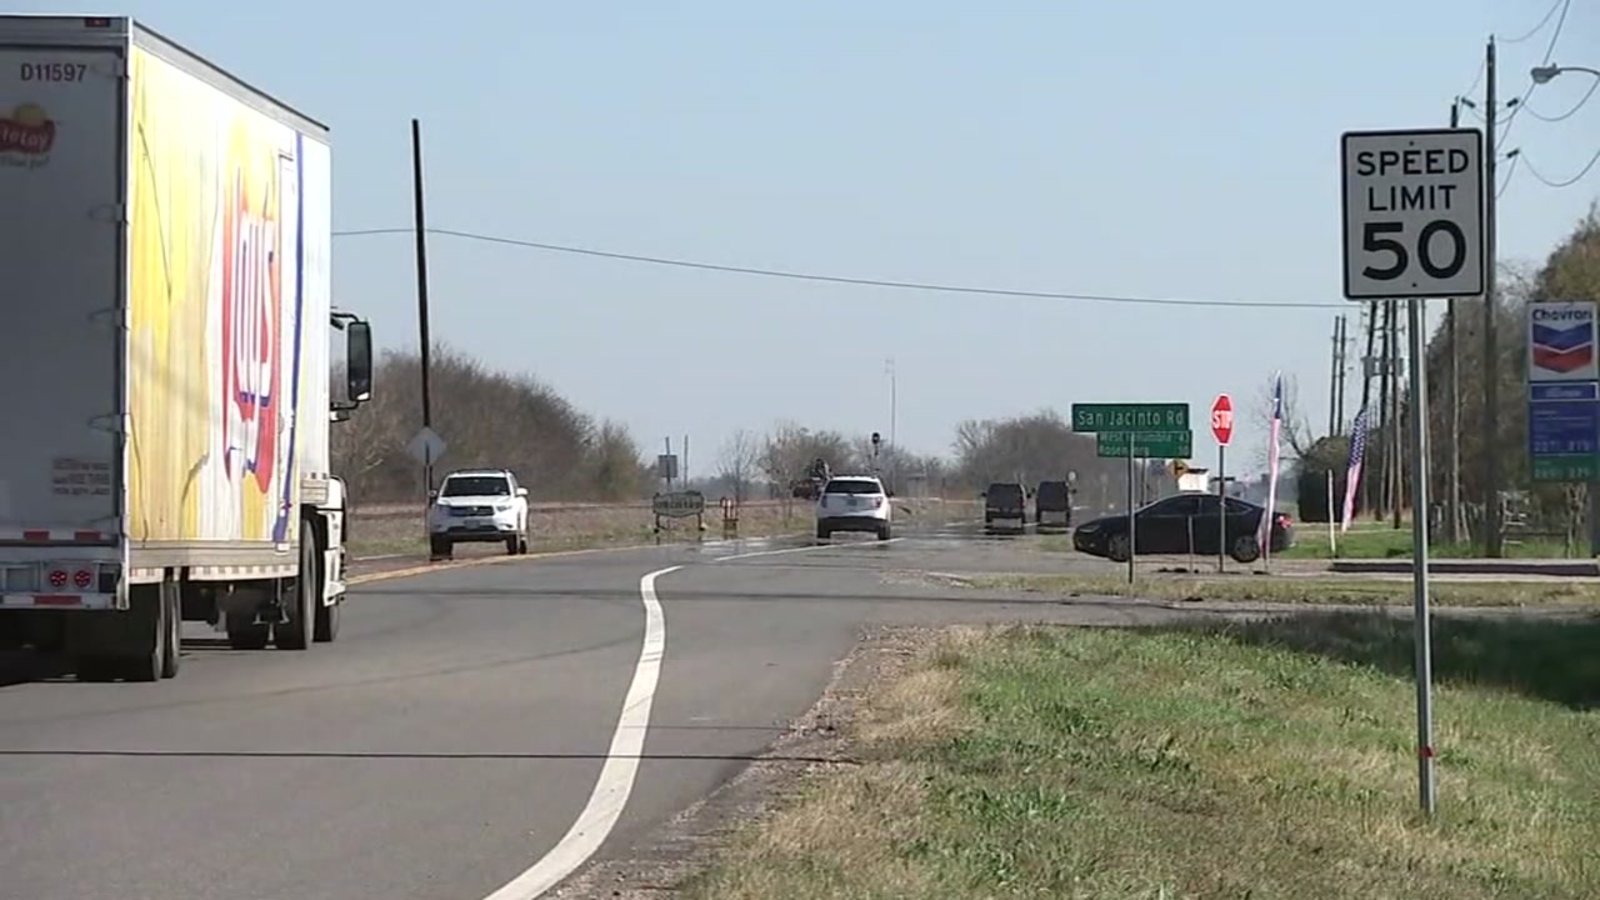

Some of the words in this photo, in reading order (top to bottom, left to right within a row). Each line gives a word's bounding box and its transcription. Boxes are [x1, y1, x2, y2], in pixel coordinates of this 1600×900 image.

[20, 63, 87, 82] D11597
[1357, 148, 1469, 176] SPEED
[1368, 184, 1457, 212] LIMIT
[1362, 219, 1467, 281] 50
[1532, 308, 1593, 320] Chevron
[1078, 410, 1103, 426] San
[1109, 410, 1161, 426] Jacinto
[1166, 410, 1185, 425] Rd
